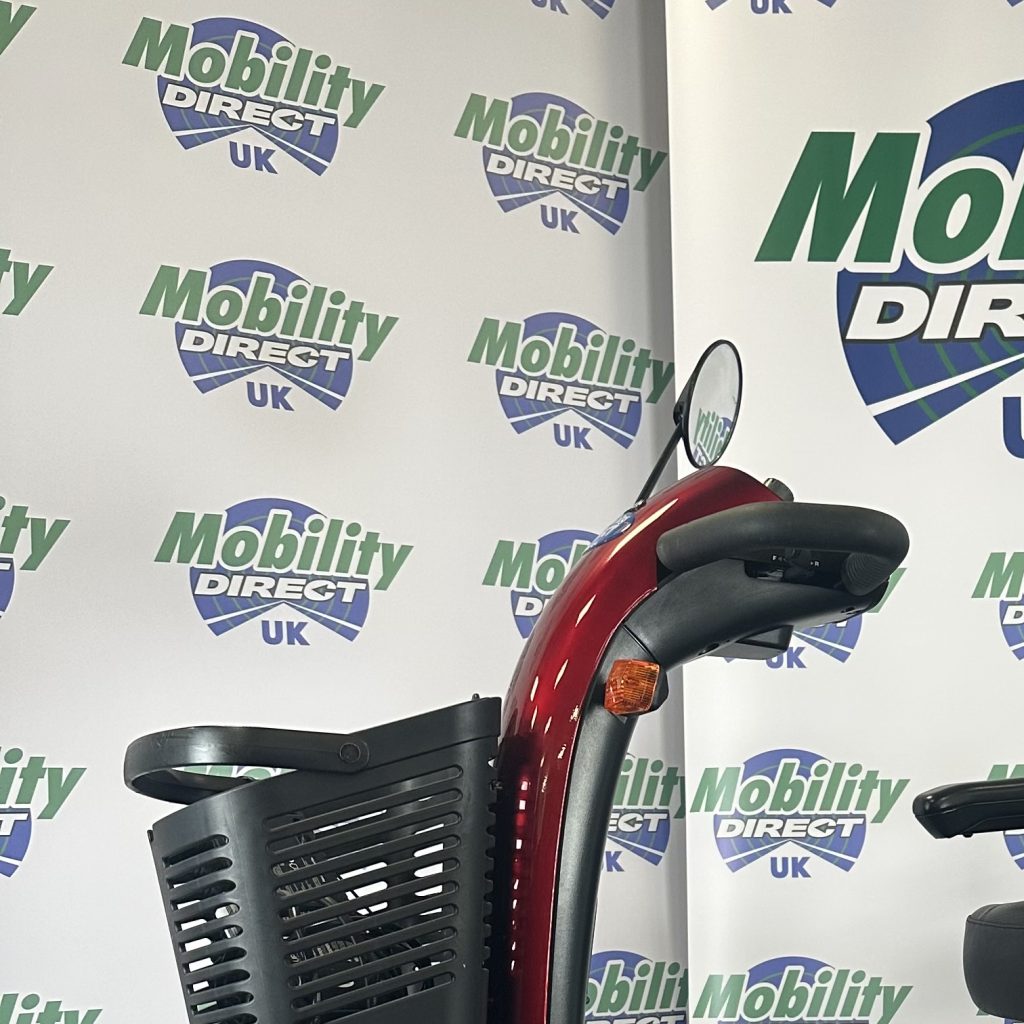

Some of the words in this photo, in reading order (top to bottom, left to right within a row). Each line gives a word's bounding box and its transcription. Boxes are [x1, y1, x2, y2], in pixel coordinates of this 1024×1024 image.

[123, 17, 384, 128] Mobility
[161, 83, 336, 137] DIRECT
[229, 141, 278, 175] UK
[455, 96, 665, 192] Mobility
[485, 153, 626, 199] DIRECT
[540, 203, 580, 234] UK
[139, 266, 399, 363] Mobility
[179, 329, 349, 372] DIRECT
[468, 316, 675, 406] Mobility
[246, 381, 294, 411] UK
[499, 377, 639, 414] DIRECT
[554, 425, 590, 448] UK
[154, 512, 413, 592] Mobility
[194, 573, 365, 603] DIRECT
[261, 620, 308, 645] UK
[688, 760, 911, 826] Mobility
[717, 816, 862, 839] DIRECT
[770, 856, 809, 879] UK
